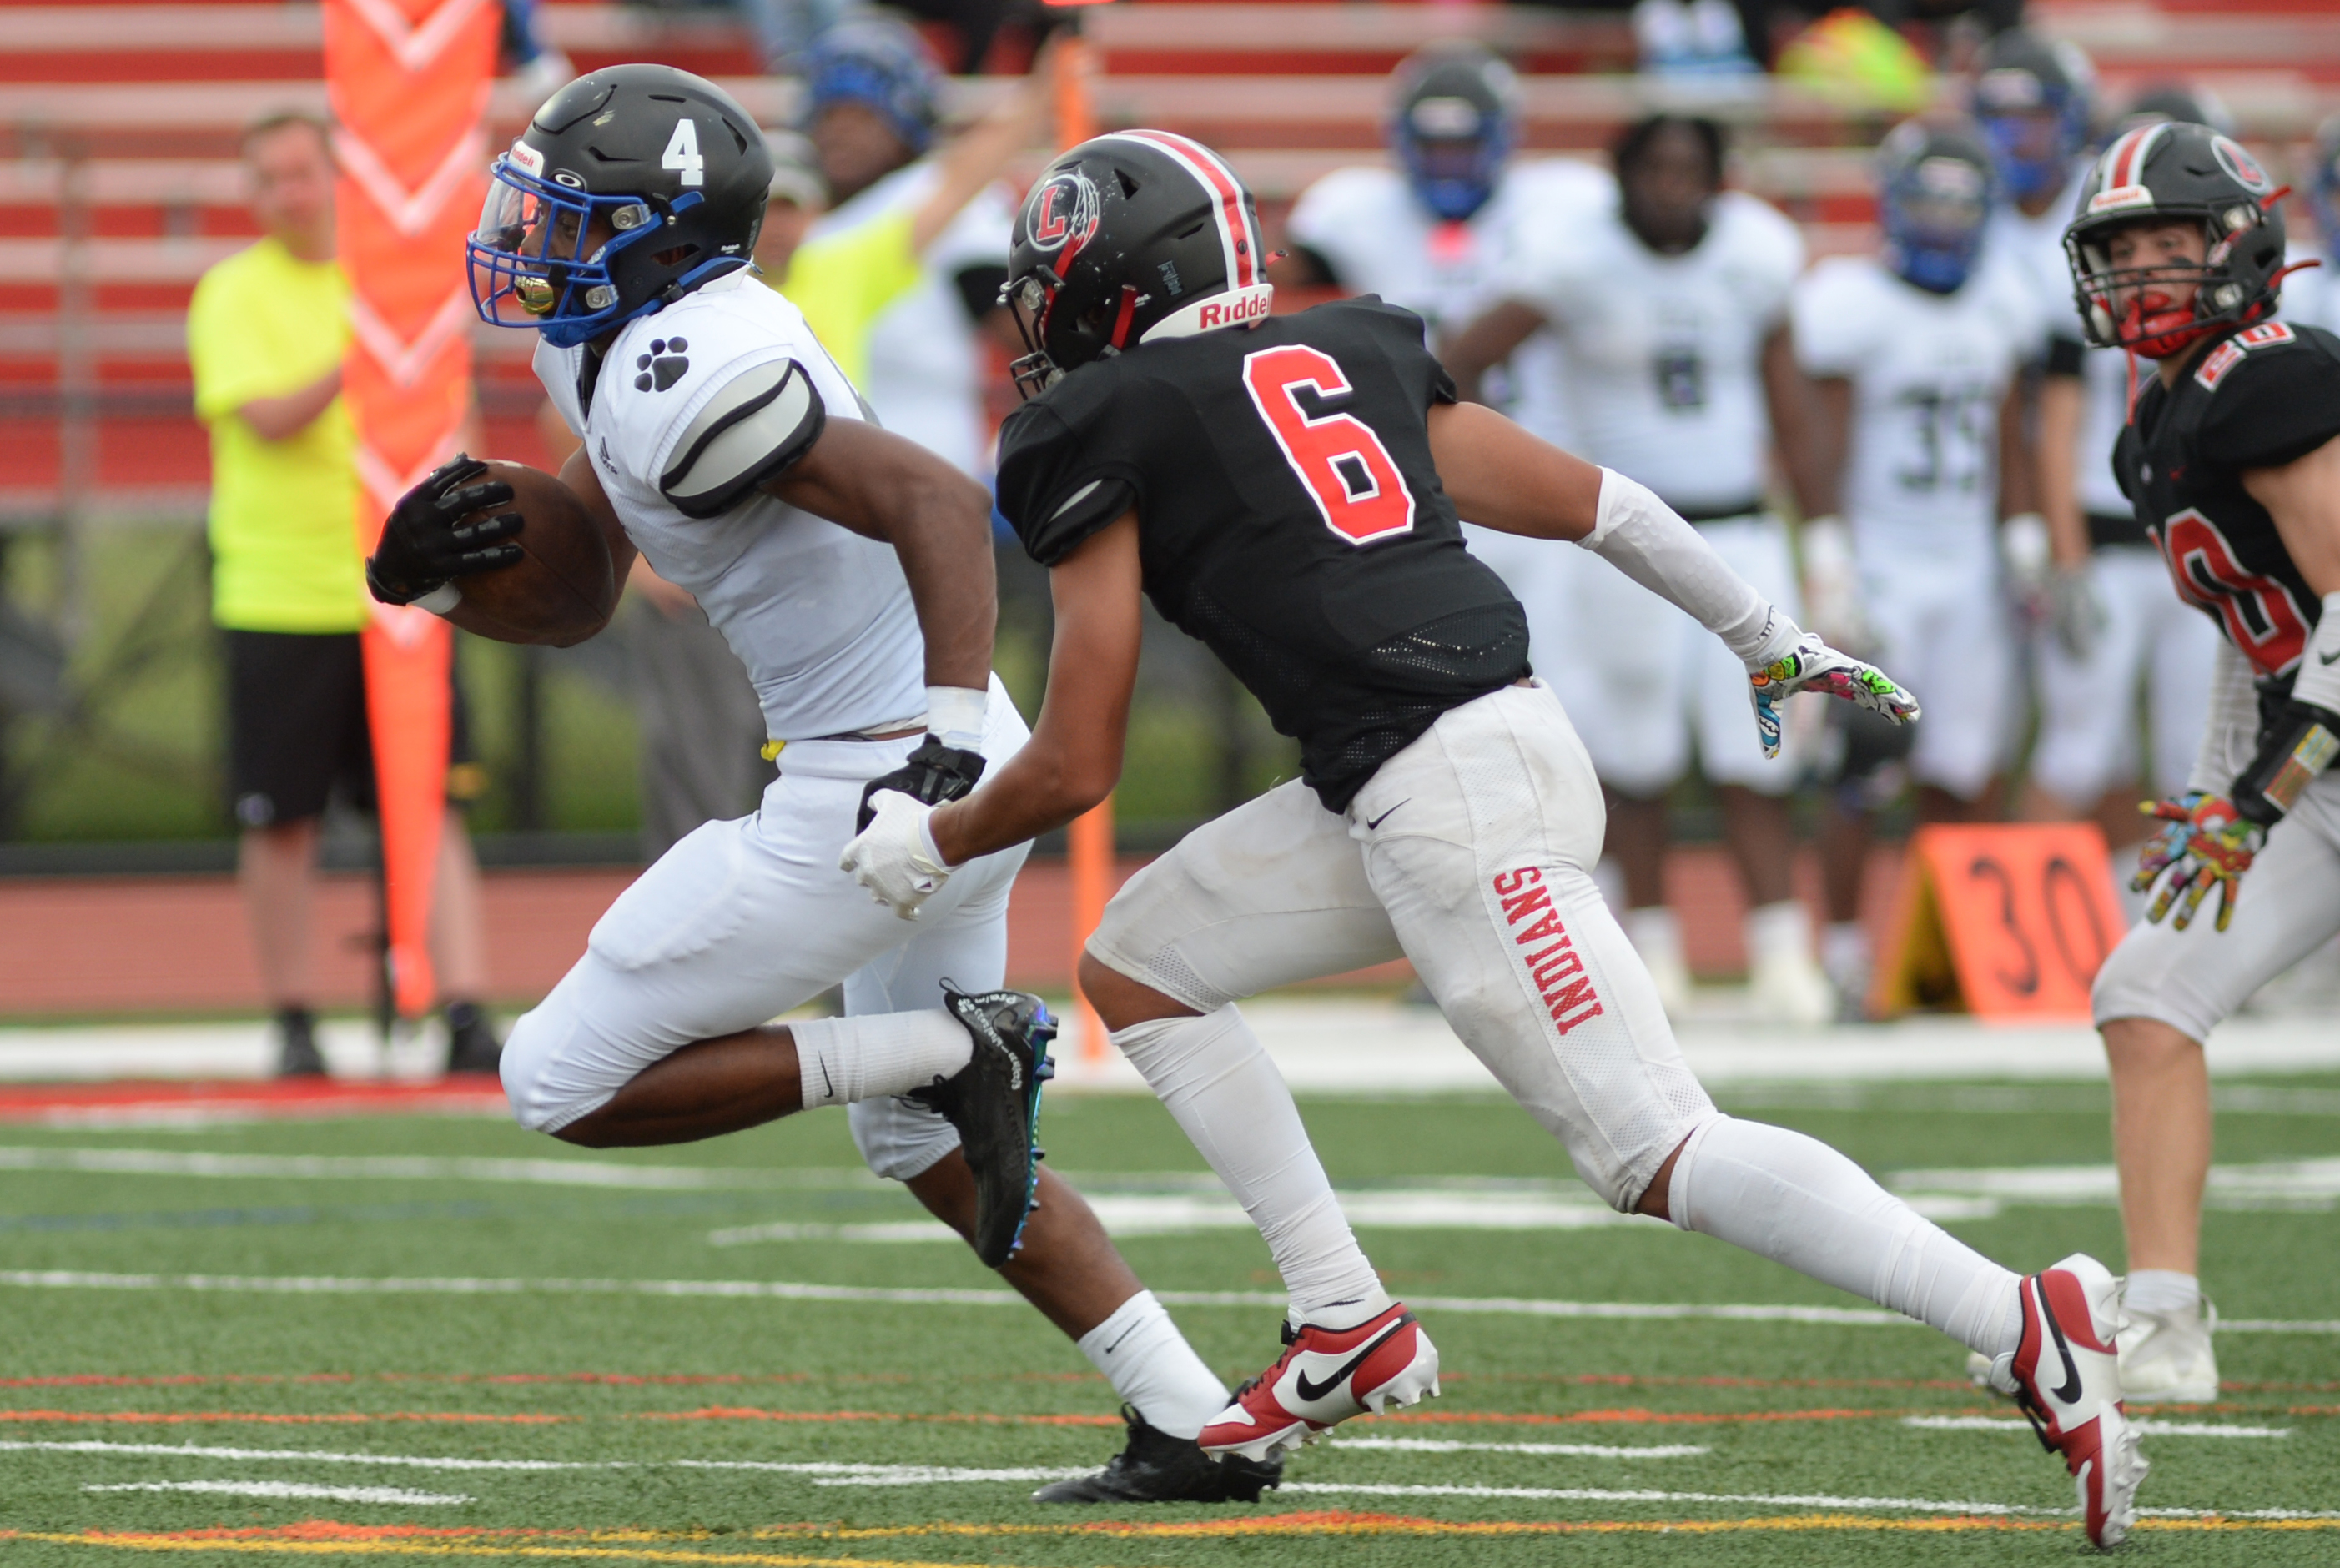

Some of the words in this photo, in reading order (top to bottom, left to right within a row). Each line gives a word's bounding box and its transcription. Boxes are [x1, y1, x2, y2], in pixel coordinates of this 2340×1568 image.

[661, 118, 703, 186] 4
[1035, 185, 1065, 243] L
[1200, 293, 1272, 329] Riddel
[2193, 320, 2297, 392] 20
[1242, 344, 1416, 545] 6
[1492, 865, 1604, 1036] INDIANS
[1969, 853, 2111, 999] 30
